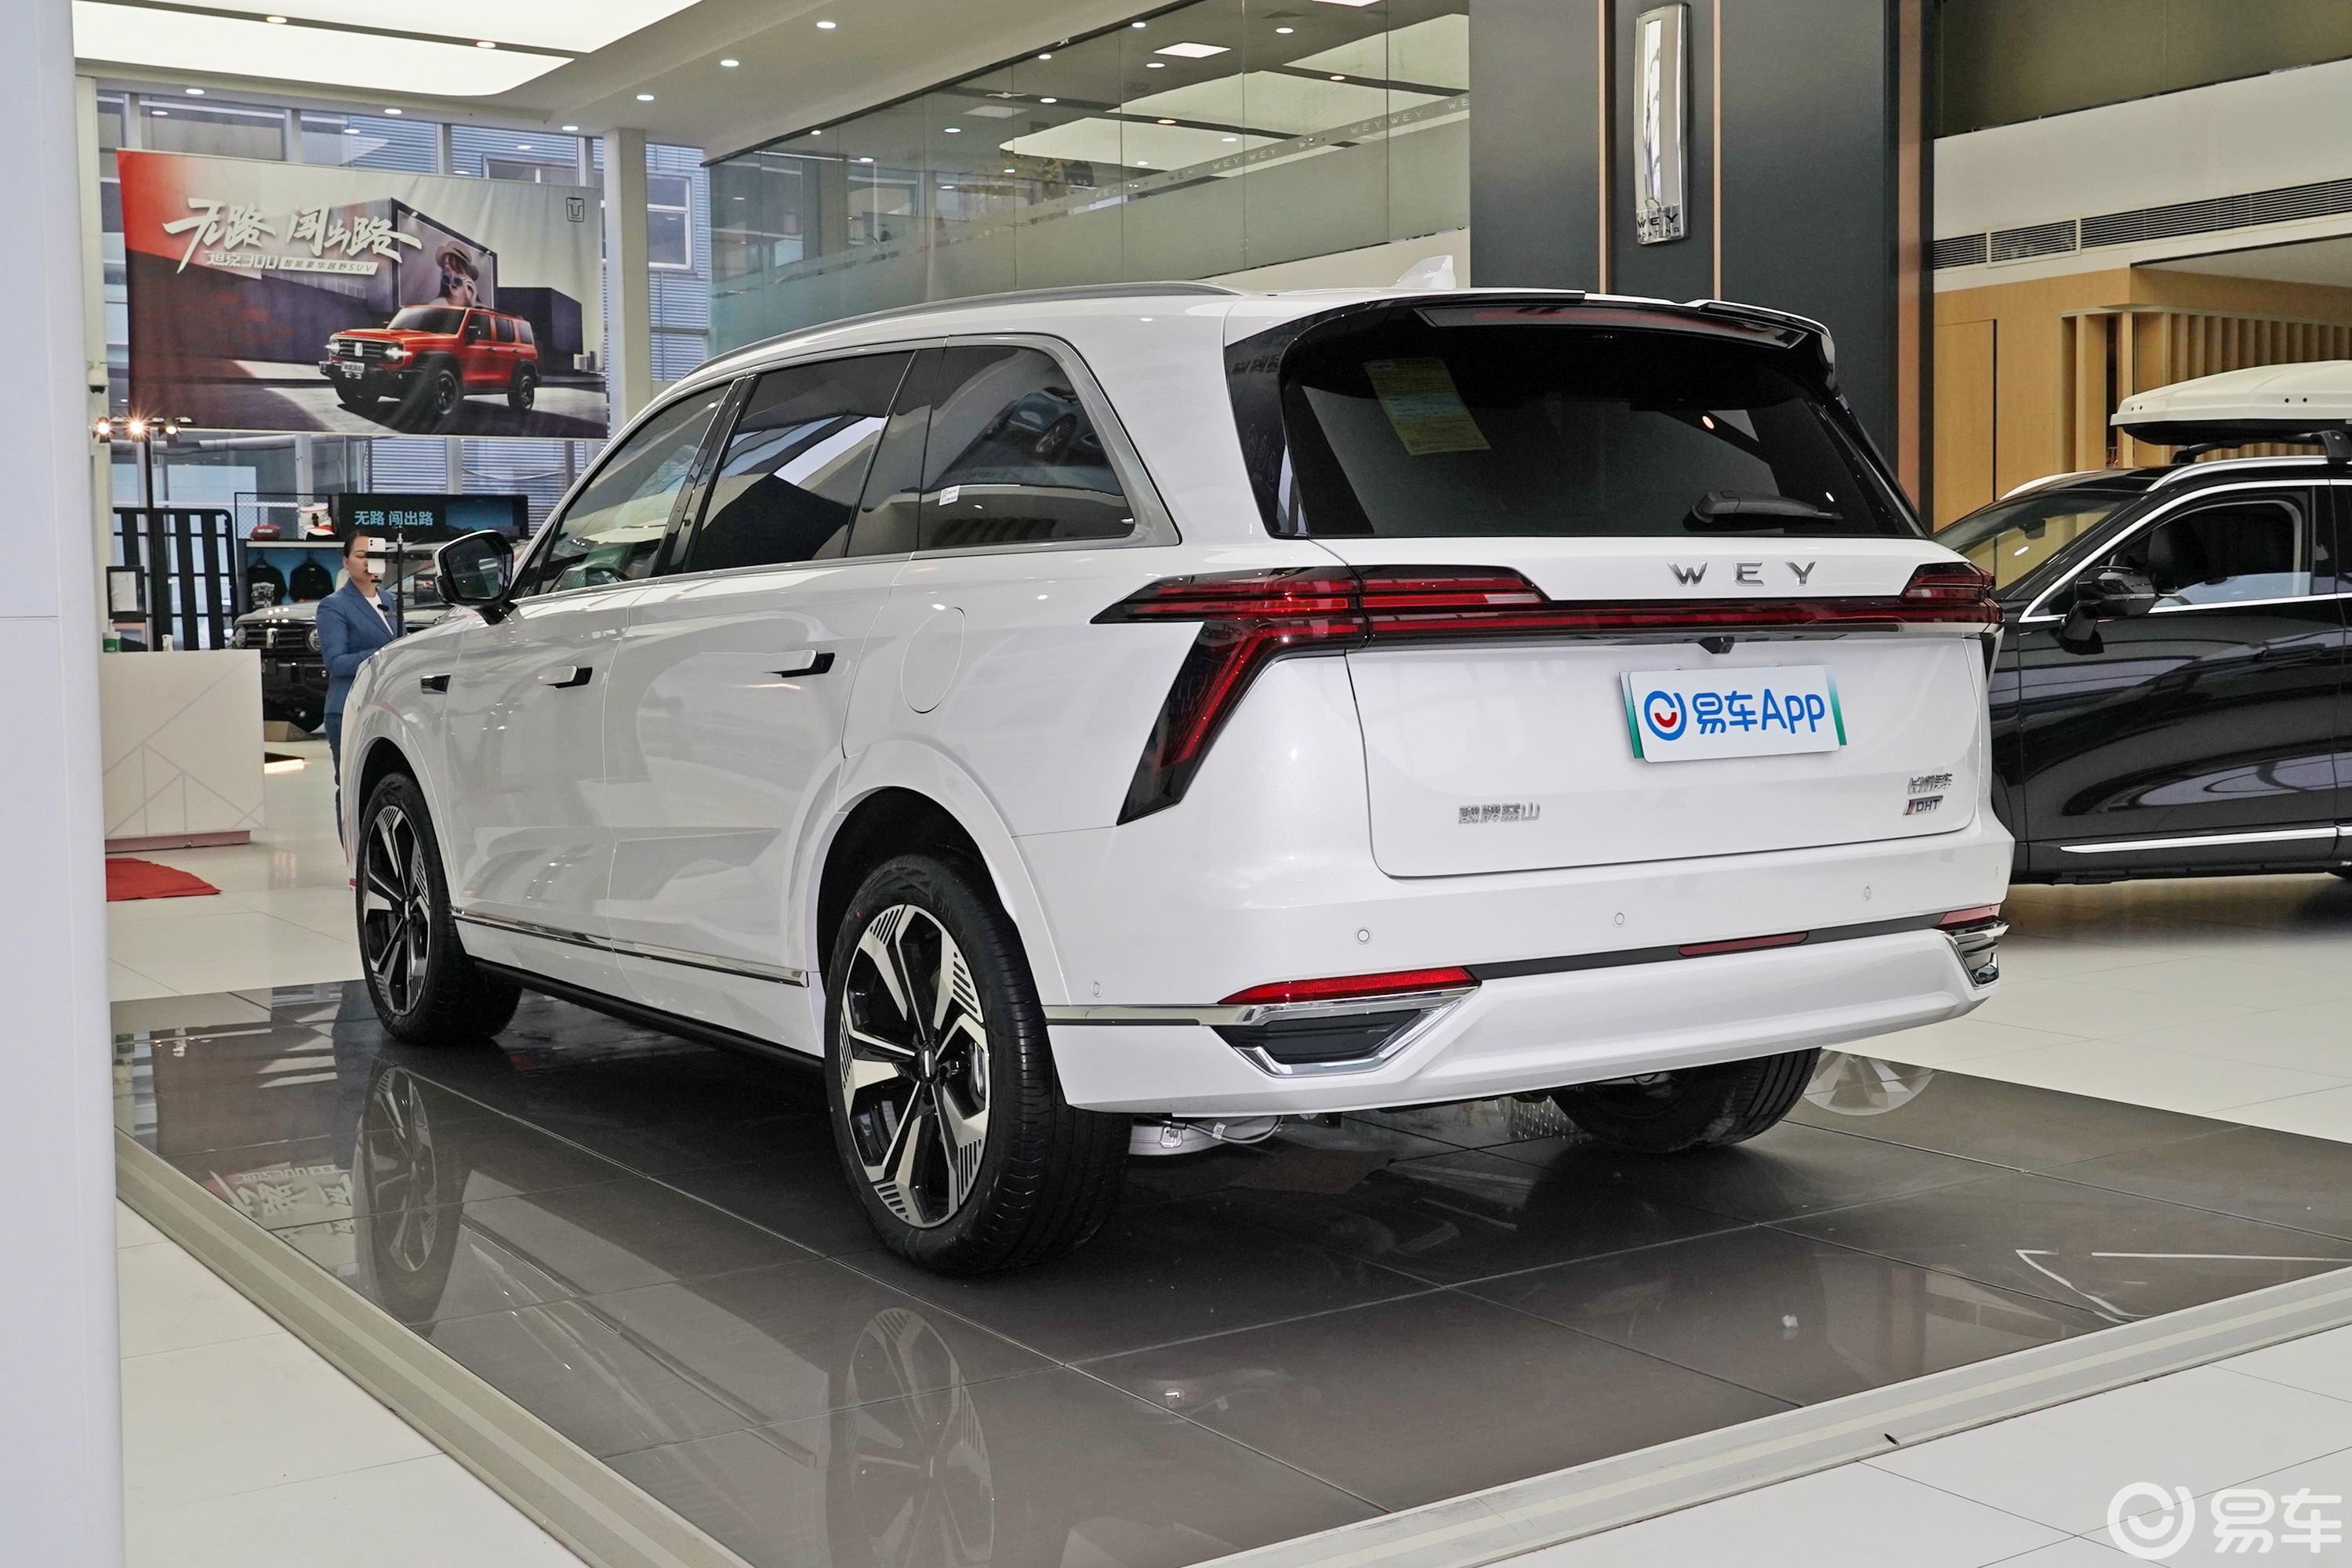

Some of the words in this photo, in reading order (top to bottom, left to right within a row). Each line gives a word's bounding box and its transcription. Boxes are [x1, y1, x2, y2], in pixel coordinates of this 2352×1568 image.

[1213, 158, 1240, 169] WEY
[1248, 148, 1276, 161] WEY
[1350, 121, 1381, 134] WEY
[1391, 111, 1423, 124] WEY
[1447, 98, 1469, 110] WE
[1638, 213, 1679, 228] WEY
[283, 260, 373, 272] 智能豪华越野SUV
[354, 510, 385, 525] 无路
[388, 510, 434, 526] 闯出路
[1667, 561, 1817, 586] WEY
[1692, 688, 1825, 734] 易车App
[1915, 799, 1940, 812] DHT
